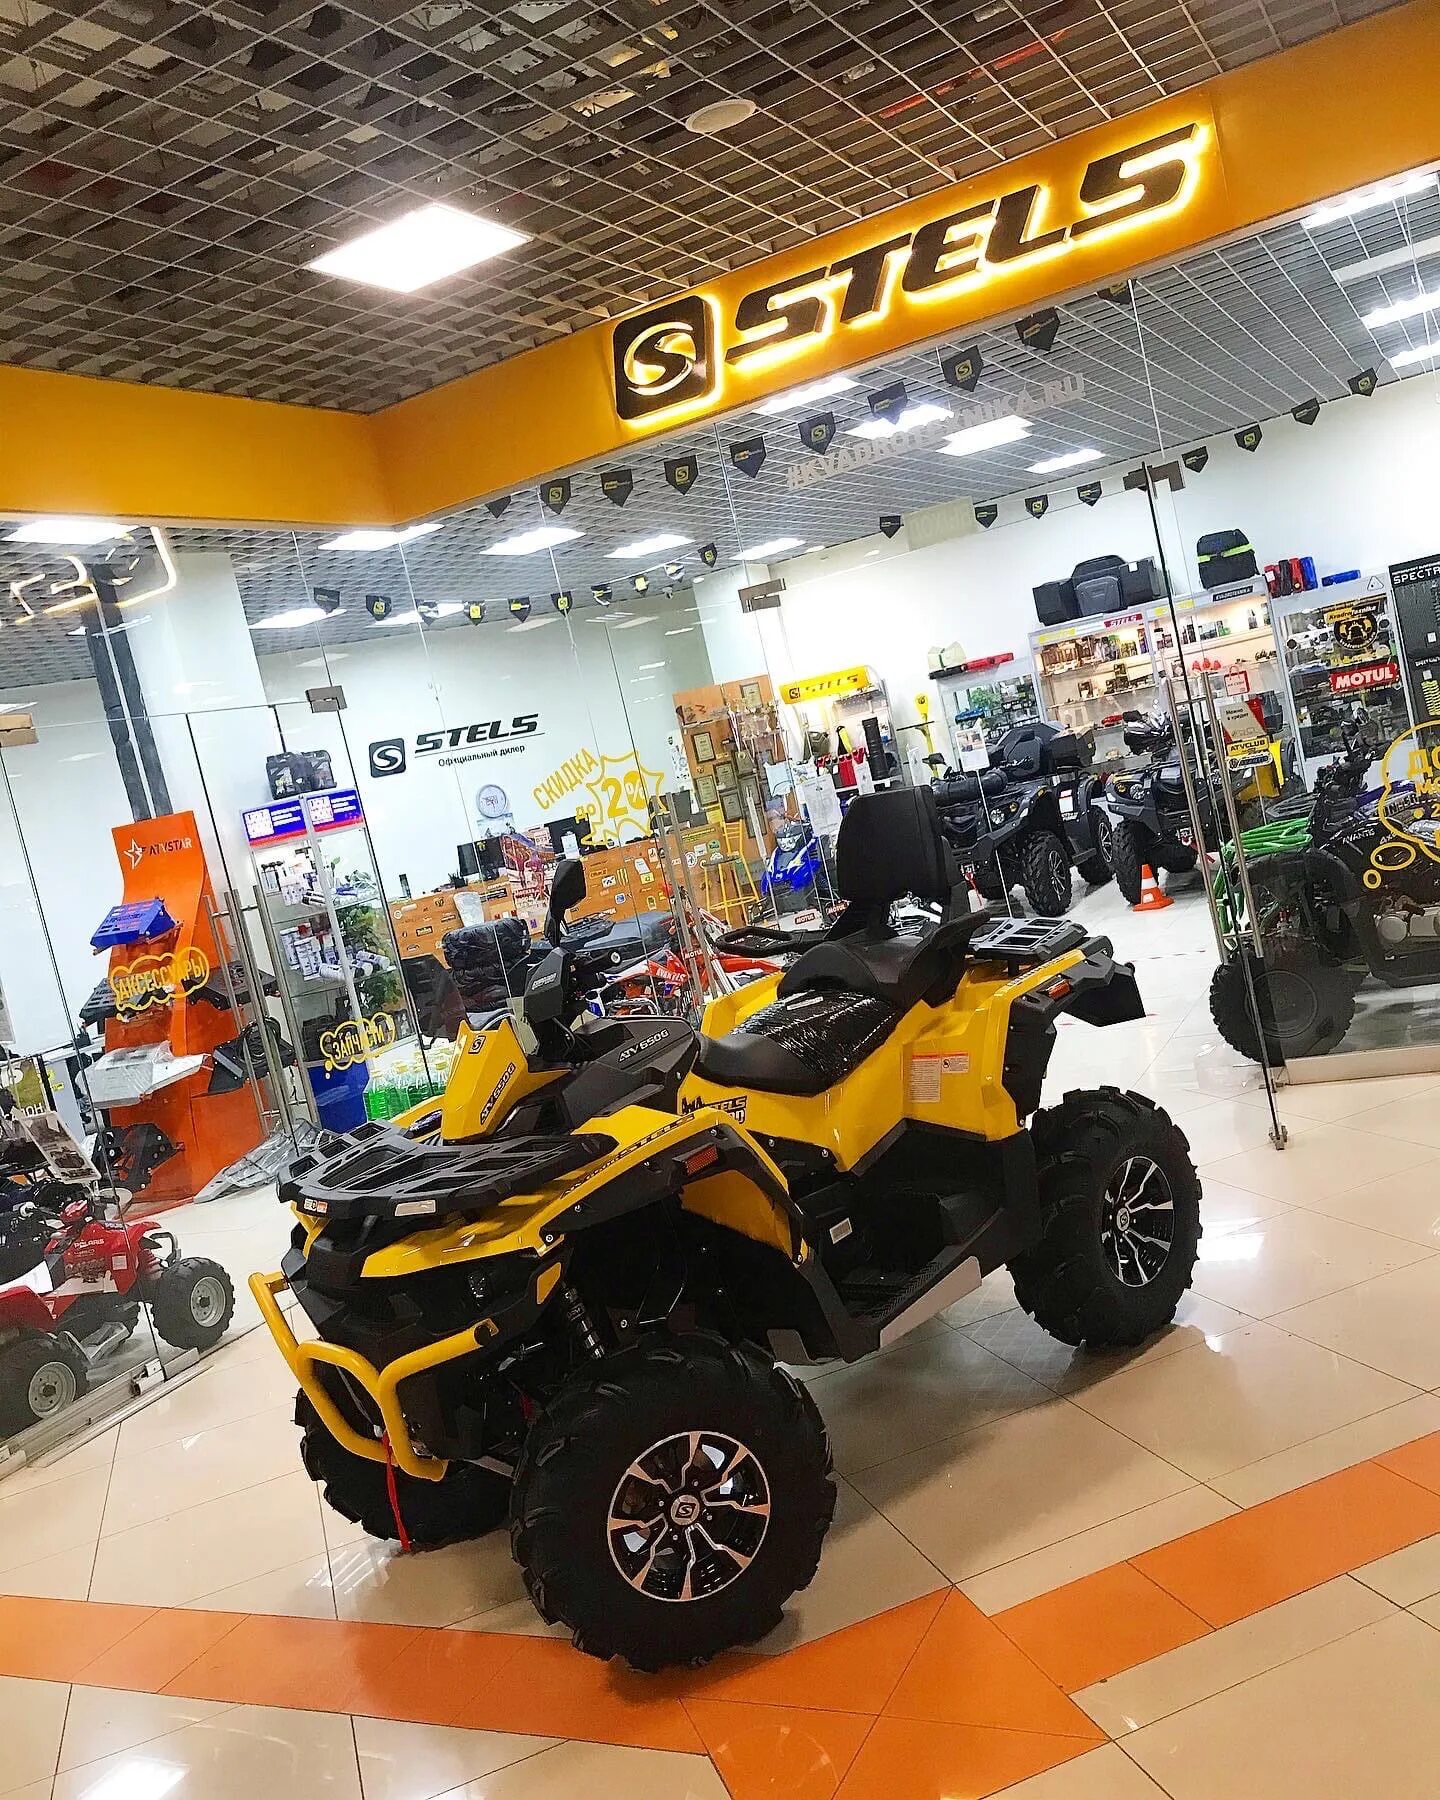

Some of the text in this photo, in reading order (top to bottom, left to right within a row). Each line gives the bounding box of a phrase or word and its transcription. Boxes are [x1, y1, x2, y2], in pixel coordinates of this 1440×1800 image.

[727, 124, 1200, 366] STELS
[1335, 666, 1394, 689] MOTUL
[415, 713, 539, 754] STELS
[1230, 740, 1266, 752] ATVCLUB
[438, 744, 525, 767] Официальный дилер
[533, 747, 599, 810] СКИДКА
[796, 914, 815, 925] MOTUL
[685, 949, 703, 959] MOTU
[332, 1024, 386, 1060] ЗАПЧАСТИ
[618, 1028, 669, 1062] ATV 650G
[480, 1062, 516, 1124] ATV 650G
[74, 1238, 105, 1248] POLARIS
